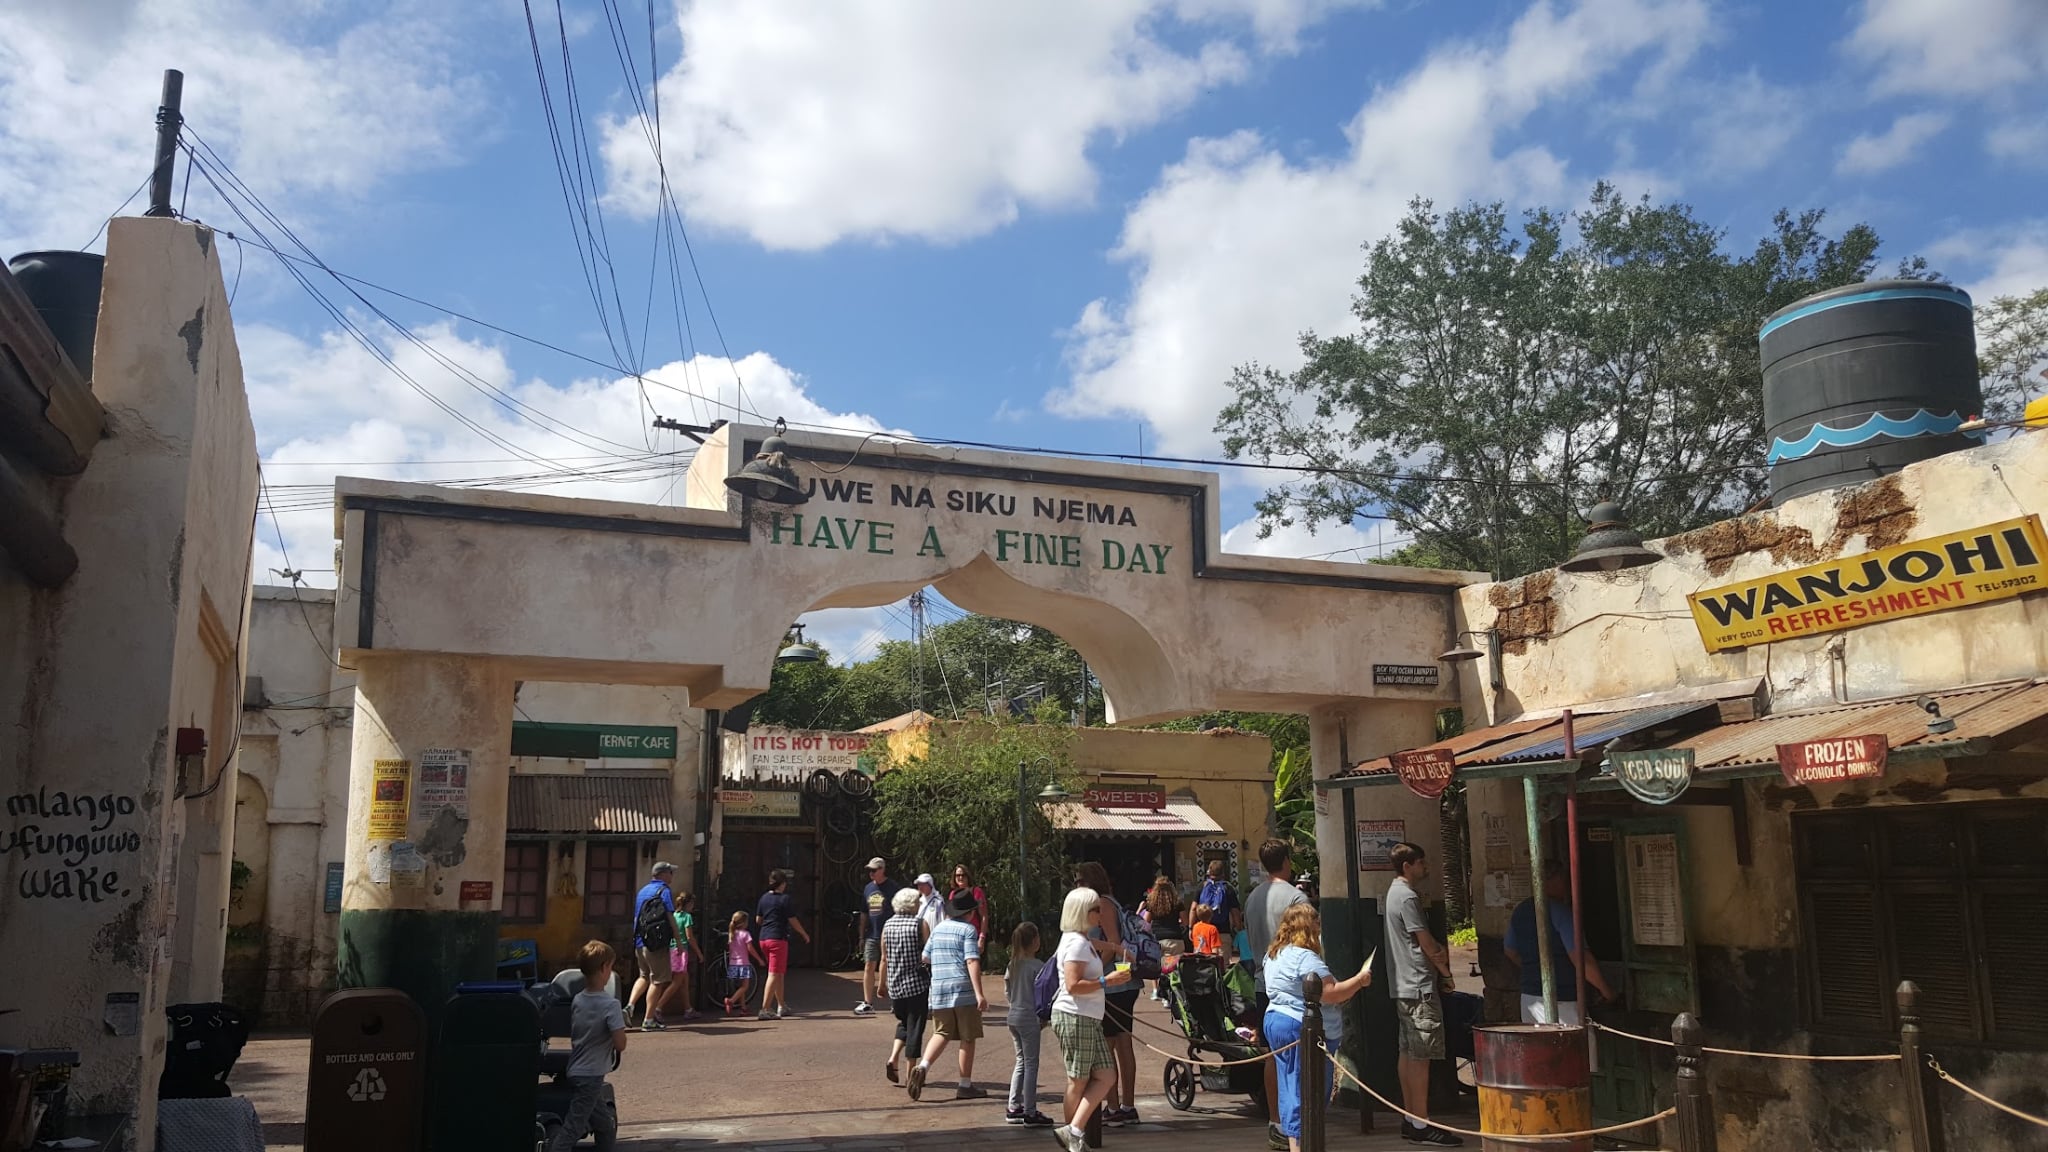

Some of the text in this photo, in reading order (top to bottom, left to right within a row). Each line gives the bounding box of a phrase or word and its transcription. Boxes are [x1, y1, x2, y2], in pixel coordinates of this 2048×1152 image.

[890, 484, 936, 508] NA
[946, 489, 1017, 517] SIKU
[770, 511, 1173, 575] HAVE A FINE DAY
[1698, 527, 2040, 627] WANJOHI
[1766, 580, 1968, 636] REFRESHMENT
[1716, 629, 1764, 643] VERY COLD
[1376, 665, 1388, 673] ASK
[1389, 666, 1398, 674] FOR
[1399, 666, 1413, 675] OCEAN
[642, 735, 671, 749] CAFE
[753, 736, 867, 751] IT IS HOT TODA
[752, 754, 852, 765] FAN SALES & REPAIRS
[1407, 753, 1438, 764] SELLING
[1804, 739, 1866, 765] FROZEN
[1398, 764, 1426, 781] COLD
[1623, 756, 1688, 780] ICED SODA
[1793, 761, 1878, 781] ALCOHOLIC DRINKS
[1089, 790, 1159, 804] SWEETS
[7, 784, 136, 832] mlango
[1647, 842, 1675, 853] DRINKS
[325, 1051, 416, 1065] BOTTLES AND CANS ONLY
